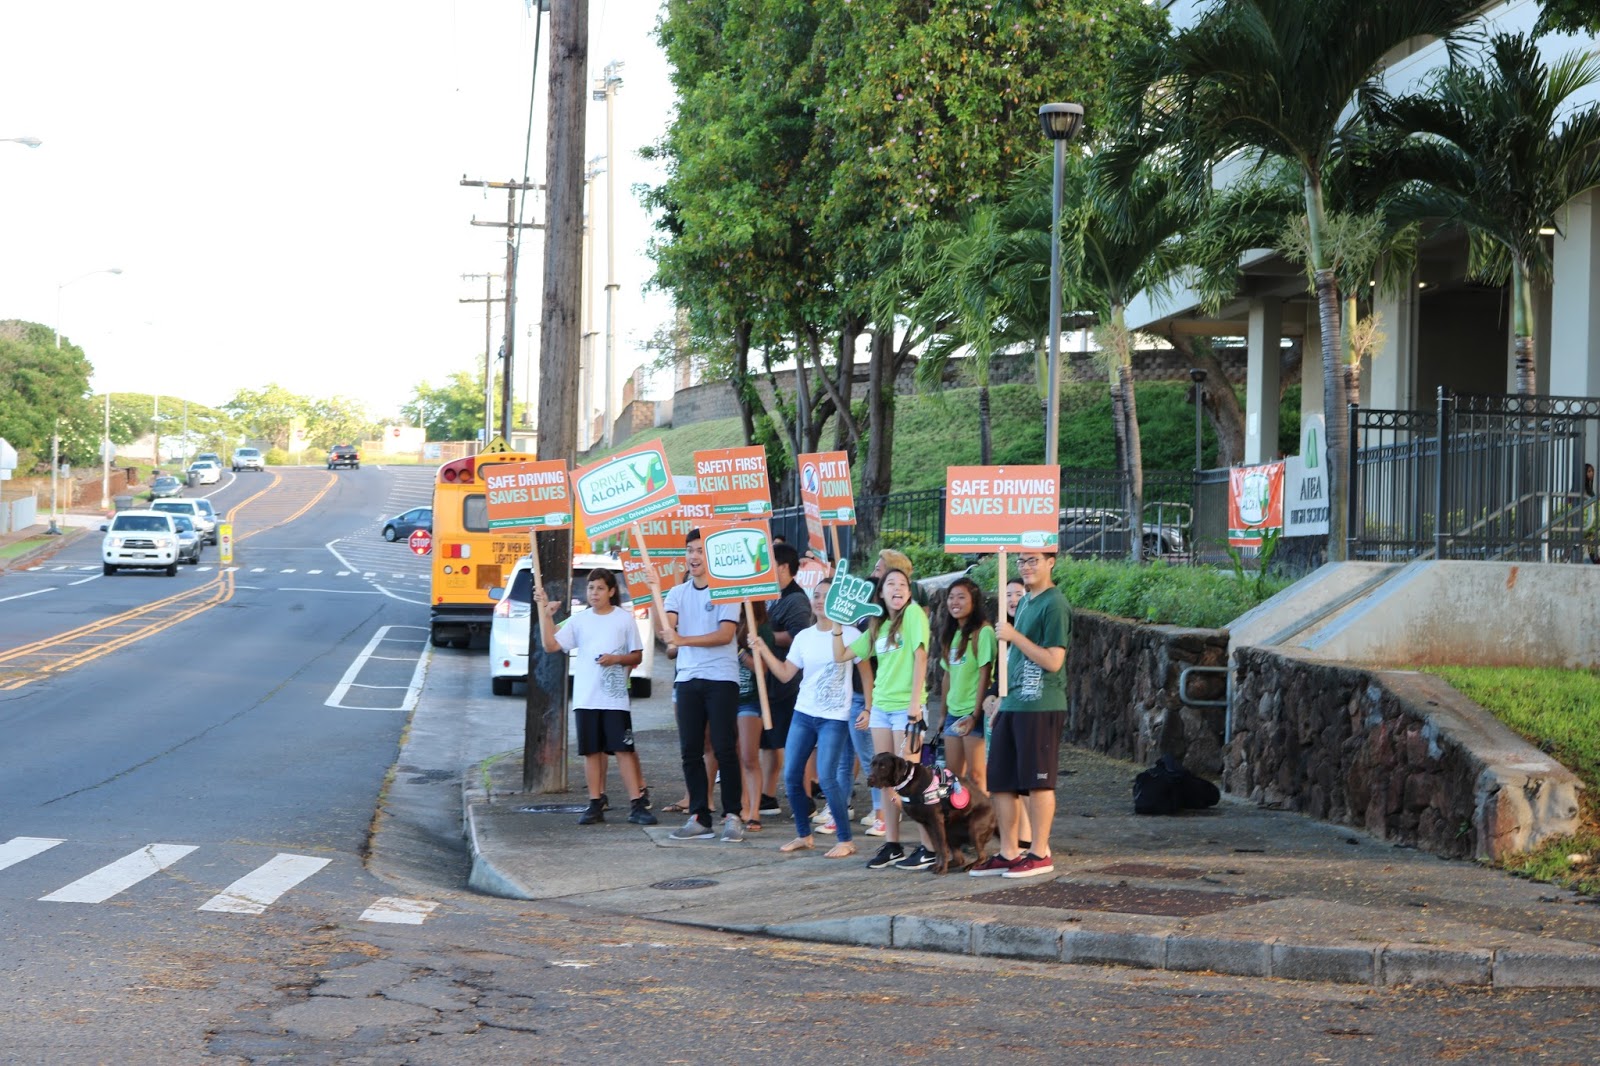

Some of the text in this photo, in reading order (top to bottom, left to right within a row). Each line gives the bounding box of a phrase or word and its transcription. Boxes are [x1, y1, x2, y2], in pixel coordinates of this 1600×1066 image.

[697, 456, 766, 474] SAFETY FIRST,
[819, 460, 847, 479] PUT IT
[487, 471, 565, 490] SAFE DRIVING
[590, 470, 630, 492] DRIVE
[699, 475, 730, 493] KEIKI
[731, 472, 765, 491] FIRST
[821, 480, 850, 498] DOWN
[950, 478, 1055, 496] SAFE DRIVING
[489, 486, 566, 505] SAVES LIVES
[591, 480, 636, 504] ALOHA
[628, 498, 676, 519] DriveAloha.com
[950, 497, 1055, 515] SAVES LIVES
[1290, 506, 1330, 525] HIGH SCHOO
[411, 538, 430, 548] STOP
[714, 542, 742, 556] DRIVE
[714, 554, 747, 568] ALOHA
[797, 571, 816, 586] PUT
[831, 603, 853, 616] Aloha
[834, 596, 856, 610] Drive
